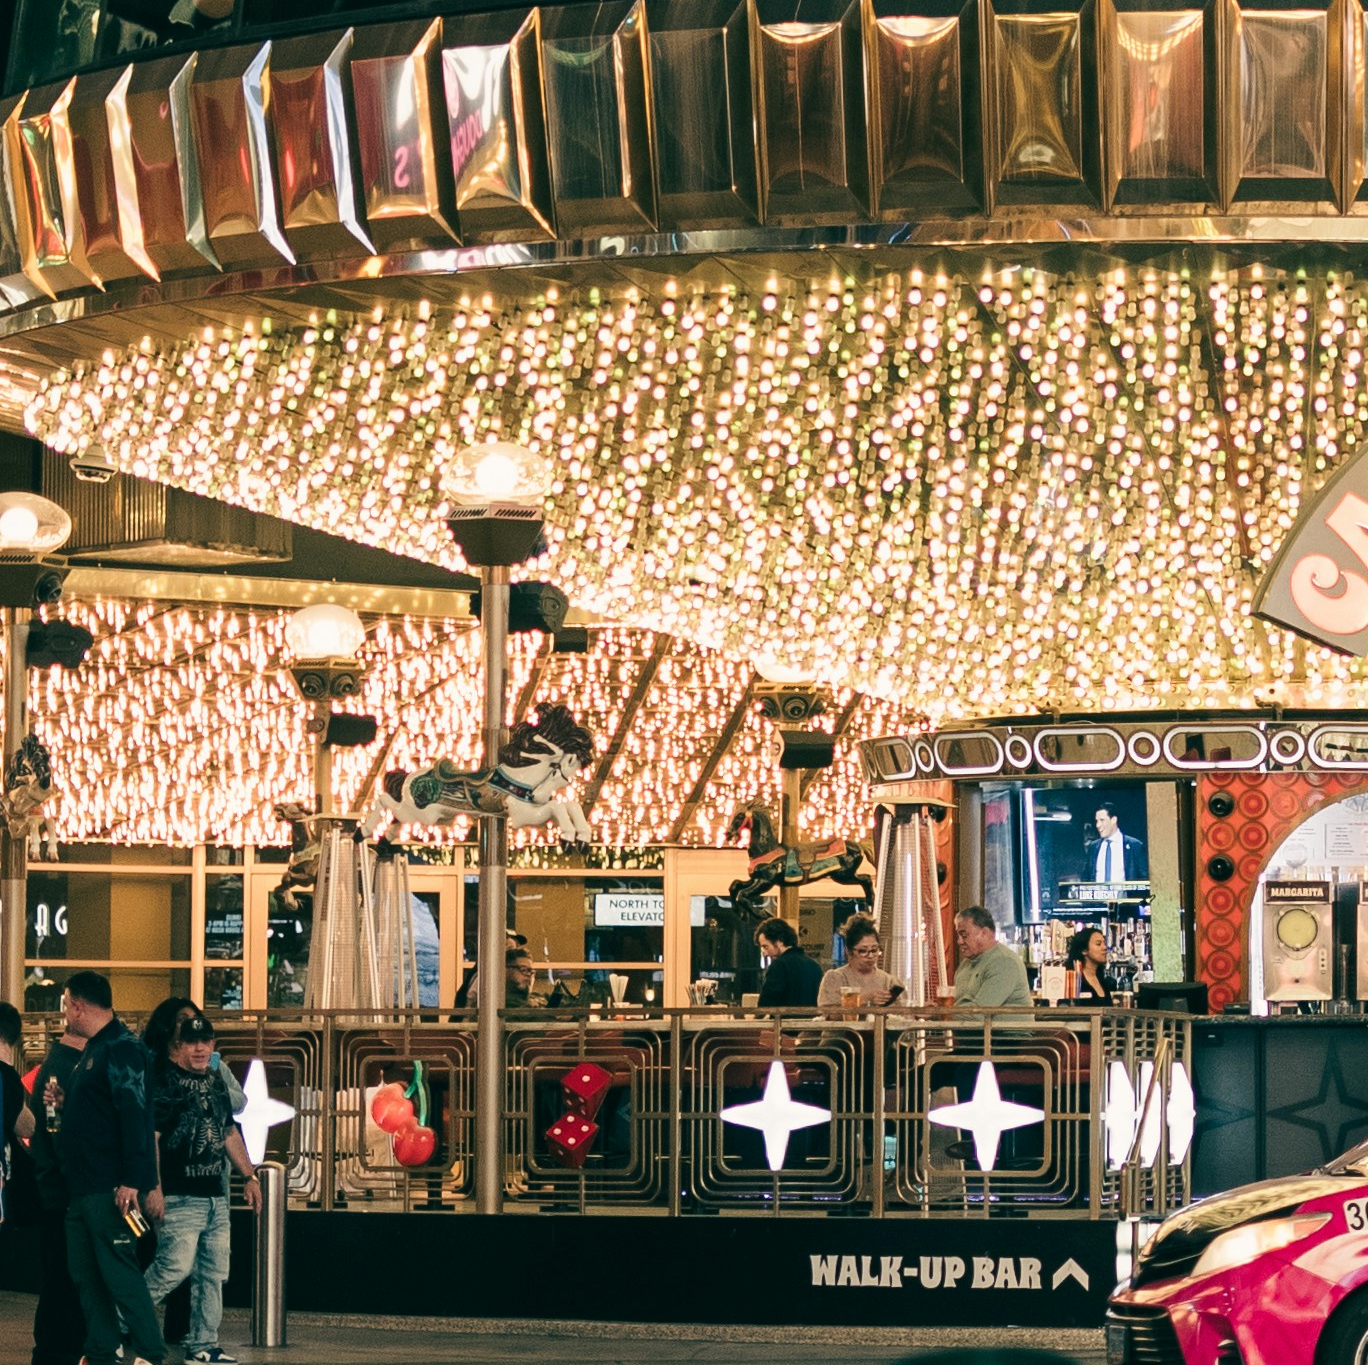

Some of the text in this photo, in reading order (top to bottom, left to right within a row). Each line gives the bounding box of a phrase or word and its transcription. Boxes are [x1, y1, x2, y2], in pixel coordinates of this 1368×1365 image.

[1270, 887, 1325, 897] MARGARITA
[609, 899, 649, 909] NORTH
[809, 1254, 1043, 1290] WALK-UP BAR
